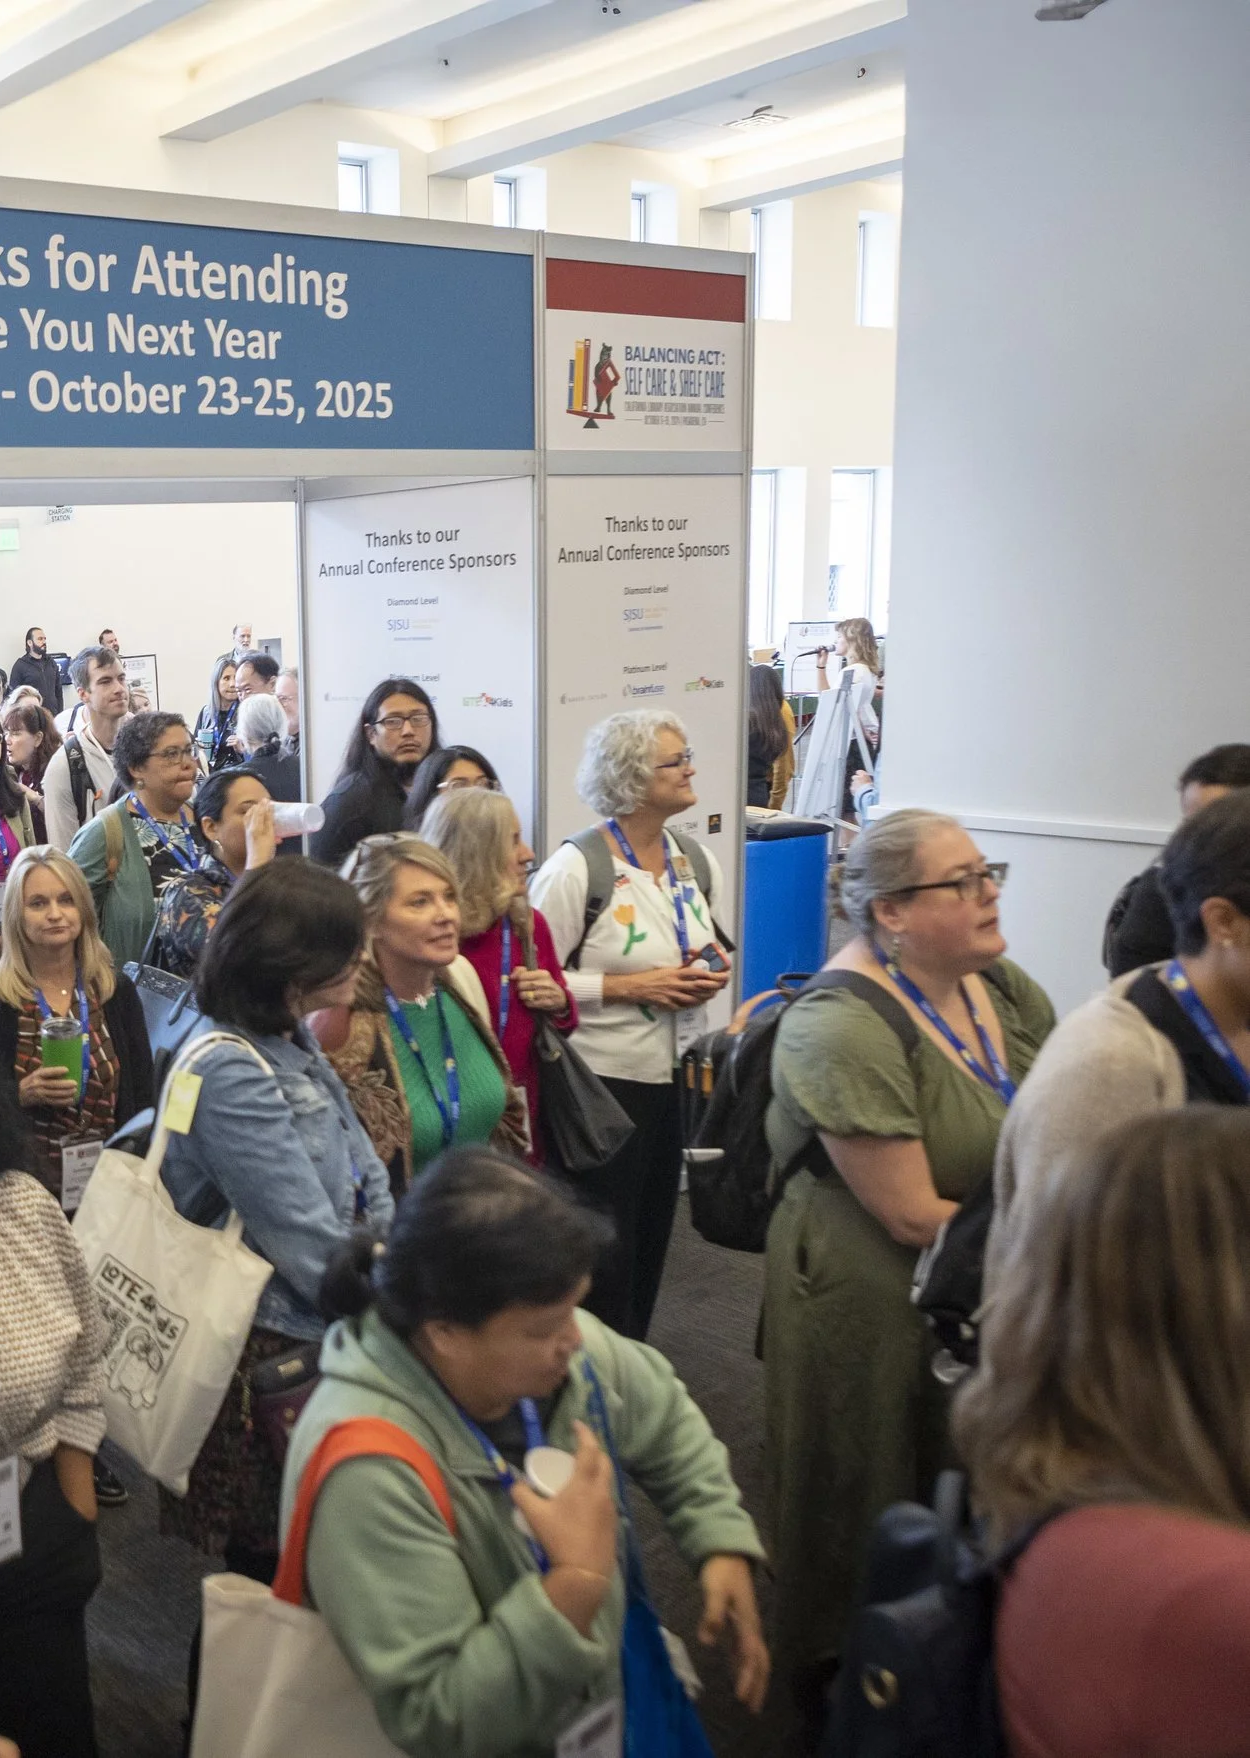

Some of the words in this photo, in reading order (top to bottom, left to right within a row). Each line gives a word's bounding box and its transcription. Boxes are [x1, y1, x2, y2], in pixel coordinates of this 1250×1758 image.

[45, 233, 116, 293] for
[131, 244, 348, 320] Attending
[19, 308, 94, 353] You
[107, 313, 194, 357] Next
[205, 319, 281, 360] Year
[624, 345, 695, 364] BALANCING
[698, 350, 725, 366] ACT:
[625, 367, 642, 396] SELF
[645, 368, 667, 397] CARE
[670, 369, 677, 397] &
[679, 369, 701, 398] SHELF
[704, 370, 725, 398] CARE
[1, 390, 16, 400] -
[27, 369, 186, 415] October
[197, 375, 304, 424] 23-25,
[315, 379, 393, 420] 2025
[605, 516, 649, 534] Thanks
[652, 517, 665, 532] to
[668, 518, 688, 532] our
[365, 530, 413, 549] Thanks
[416, 529, 432, 546] to
[435, 528, 460, 544] our
[558, 545, 603, 564] Annual
[607, 542, 675, 562] Conference
[678, 541, 730, 560] Sponsors
[319, 560, 363, 578] Annual
[367, 555, 444, 574] Conference
[449, 551, 517, 572] Sponsors
[624, 586, 652, 596] Diamond
[654, 584, 669, 594] Level
[387, 597, 418, 607] Diamond
[420, 596, 439, 605] Level
[387, 619, 410, 632] SJSU
[623, 608, 644, 622] SJSU
[422, 673, 440, 682] Level
